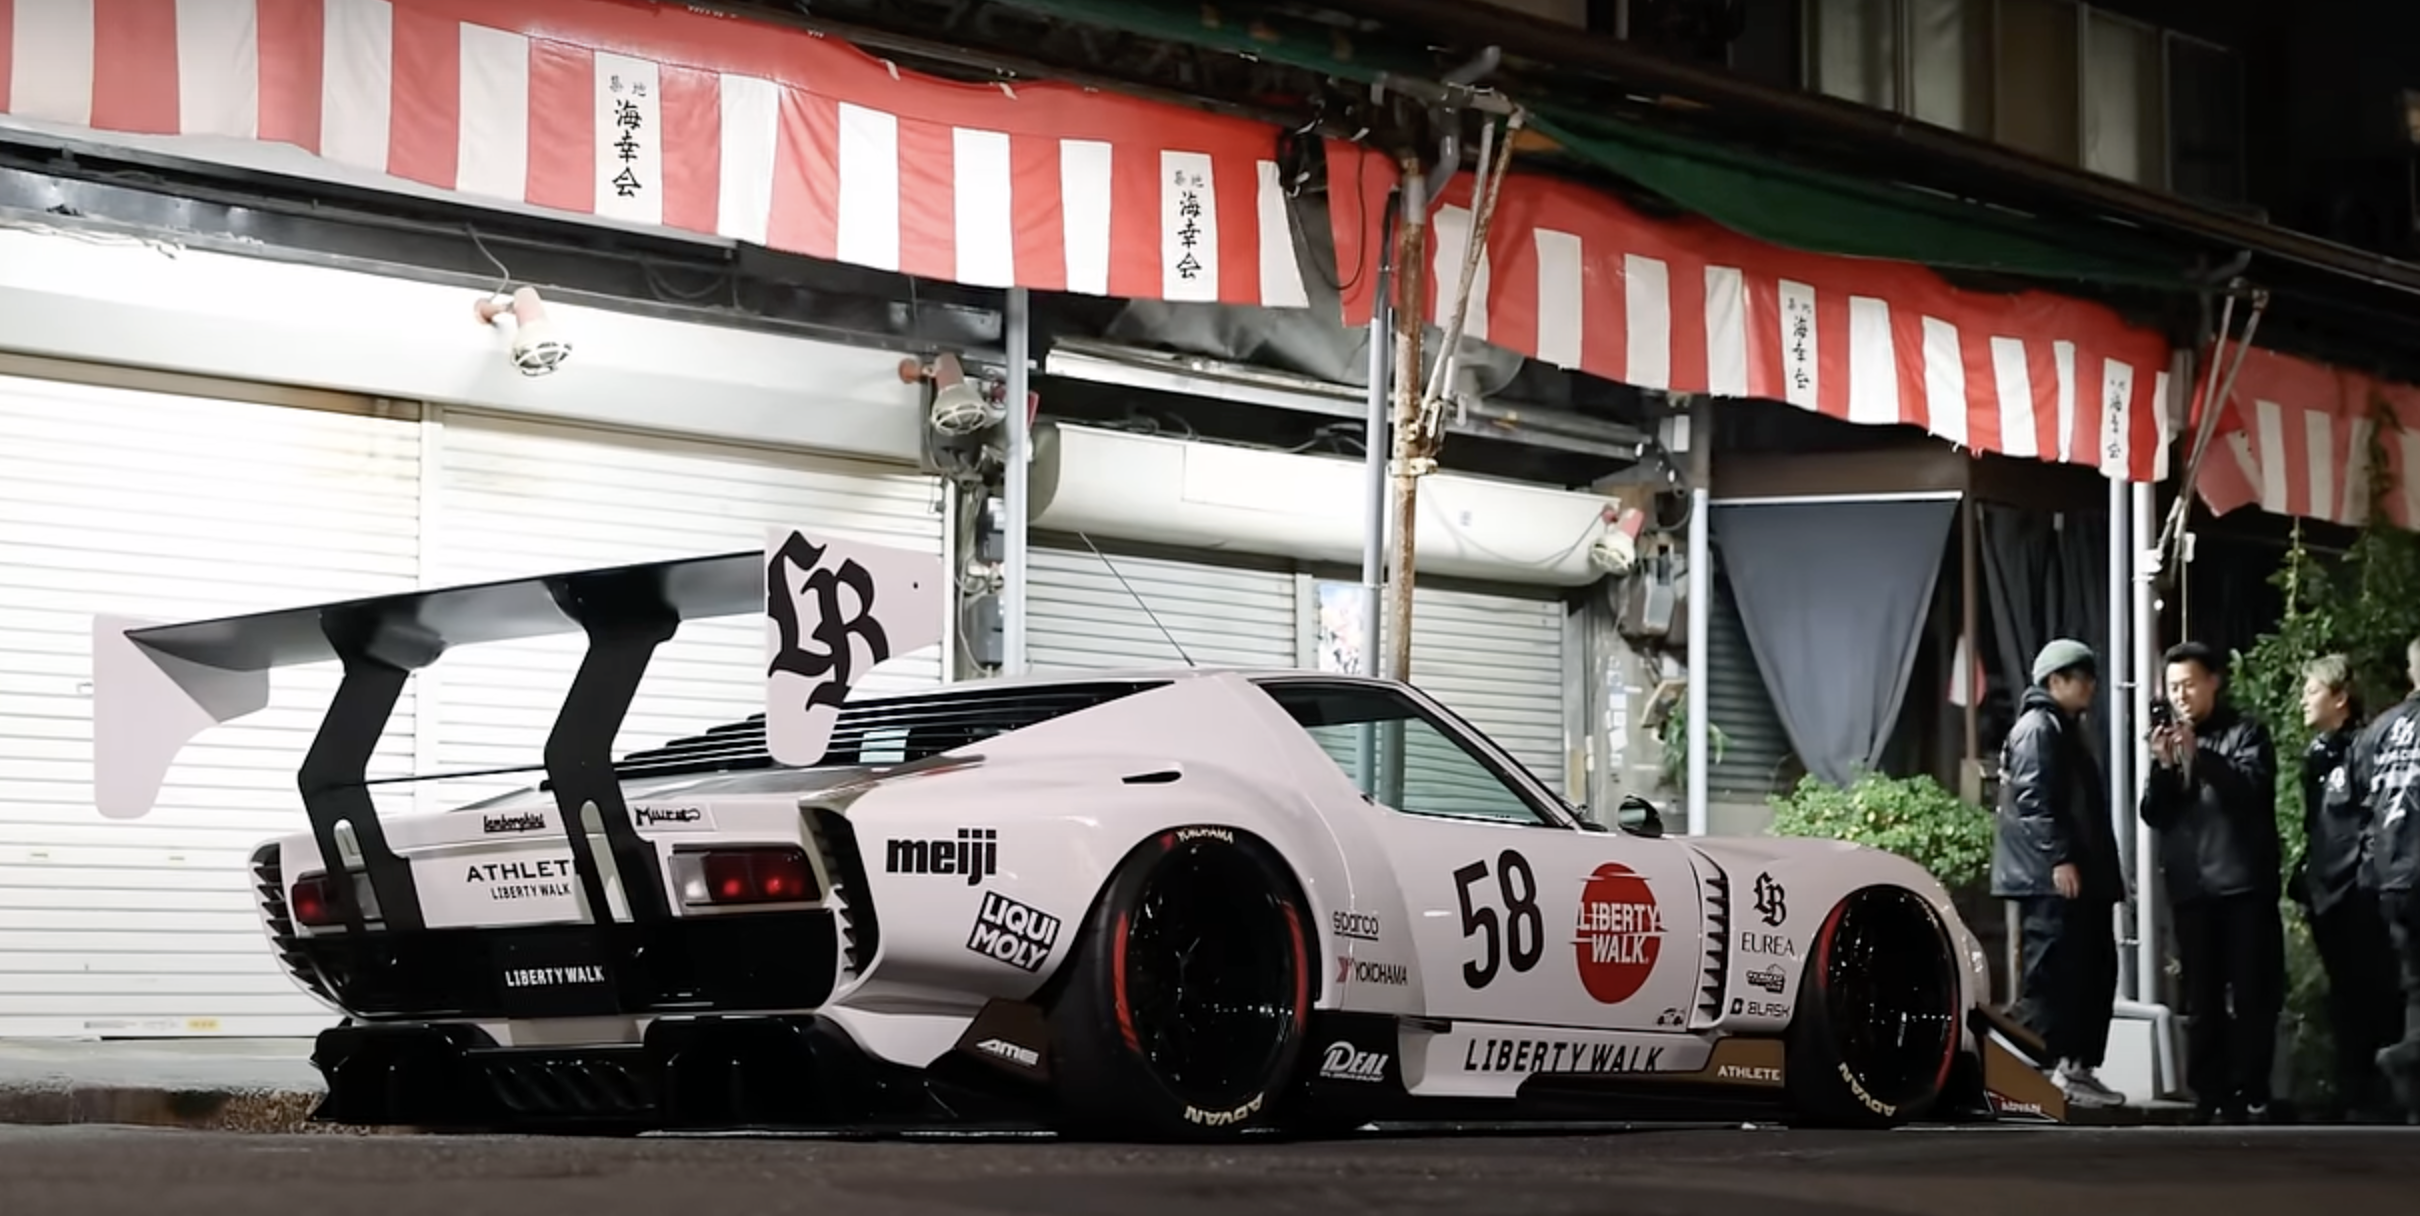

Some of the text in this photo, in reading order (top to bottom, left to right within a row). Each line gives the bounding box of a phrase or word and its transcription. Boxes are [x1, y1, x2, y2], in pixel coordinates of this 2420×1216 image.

[612, 99, 642, 197] 海幸会
[1177, 191, 1201, 279] 海幸会
[466, 859, 570, 882] ATHLET
[886, 828, 997, 886] meiji
[491, 882, 571, 900] LIBERTY WALK
[982, 894, 1058, 945] LIQUI
[1453, 849, 1544, 989] 58
[1578, 901, 1660, 933] LIBERTY
[970, 923, 1049, 969] MOLY
[1741, 931, 1795, 956] EUREA
[505, 965, 604, 986] LIBERTY WALK
[1353, 961, 1408, 985] YOKOHAMA
[1464, 1039, 1665, 1073] LIBERTY WALK
[1717, 1065, 1781, 1081] ATHLETE
[1838, 1062, 1896, 1117] ADVAN
[1184, 1091, 1264, 1126] ADVAN
